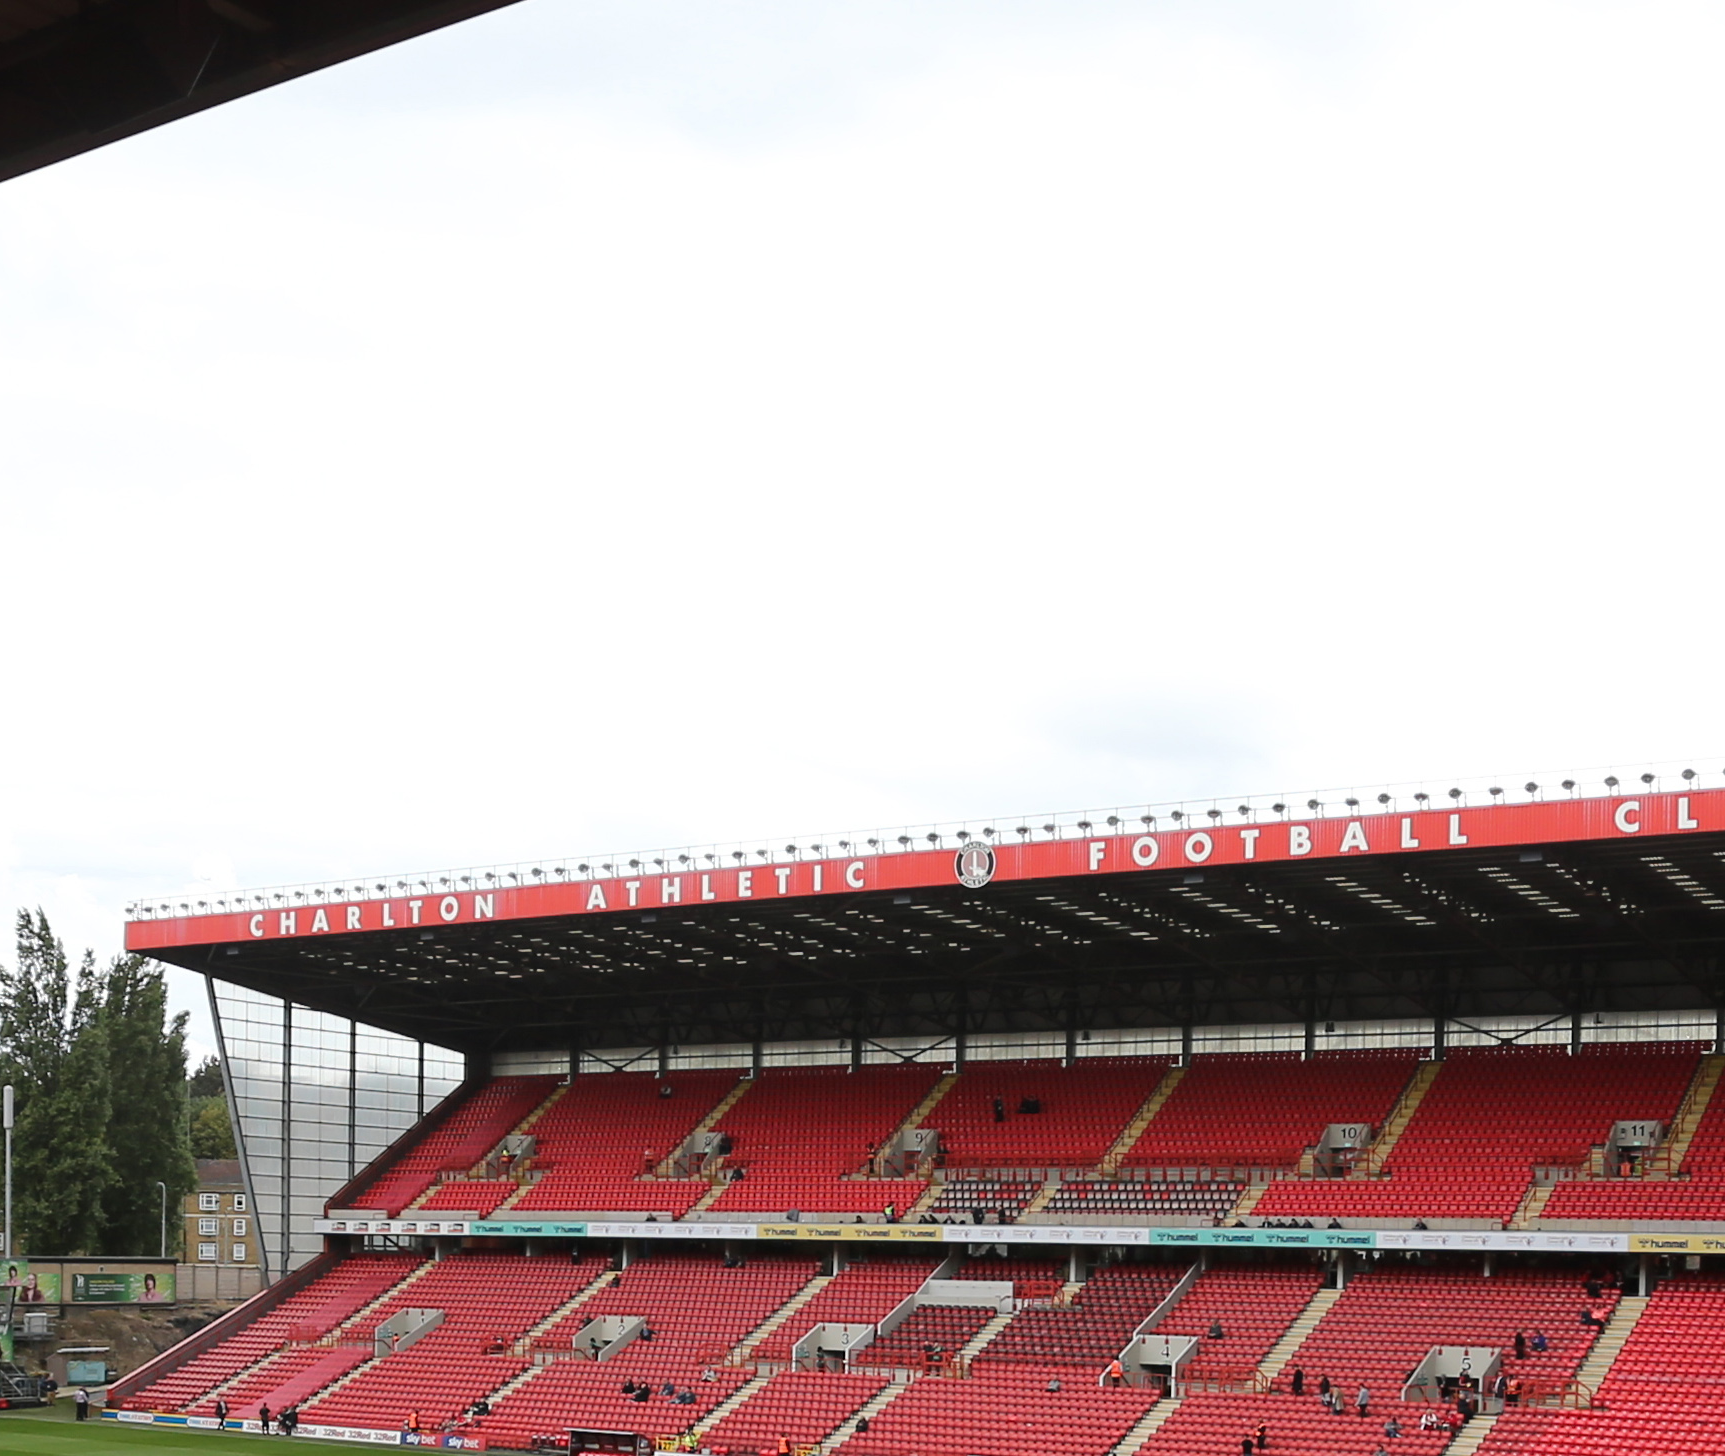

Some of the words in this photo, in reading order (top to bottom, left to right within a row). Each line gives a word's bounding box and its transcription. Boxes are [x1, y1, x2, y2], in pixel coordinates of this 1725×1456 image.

[249, 893, 495, 938] CHARLTON
[585, 860, 867, 911] ATHLETIC
[1088, 813, 1469, 871] FOOTBALL
[1166, 1233, 1198, 1241] hummel
[1222, 1234, 1254, 1242] hummel
[1277, 1235, 1309, 1243] hummel
[1337, 1235, 1370, 1244] hummel
[1650, 1239, 1688, 1248] hummel
[406, 1431, 421, 1444] sky
[421, 1433, 436, 1445] bet
[448, 1435, 463, 1449] sky
[464, 1436, 479, 1449] bet
